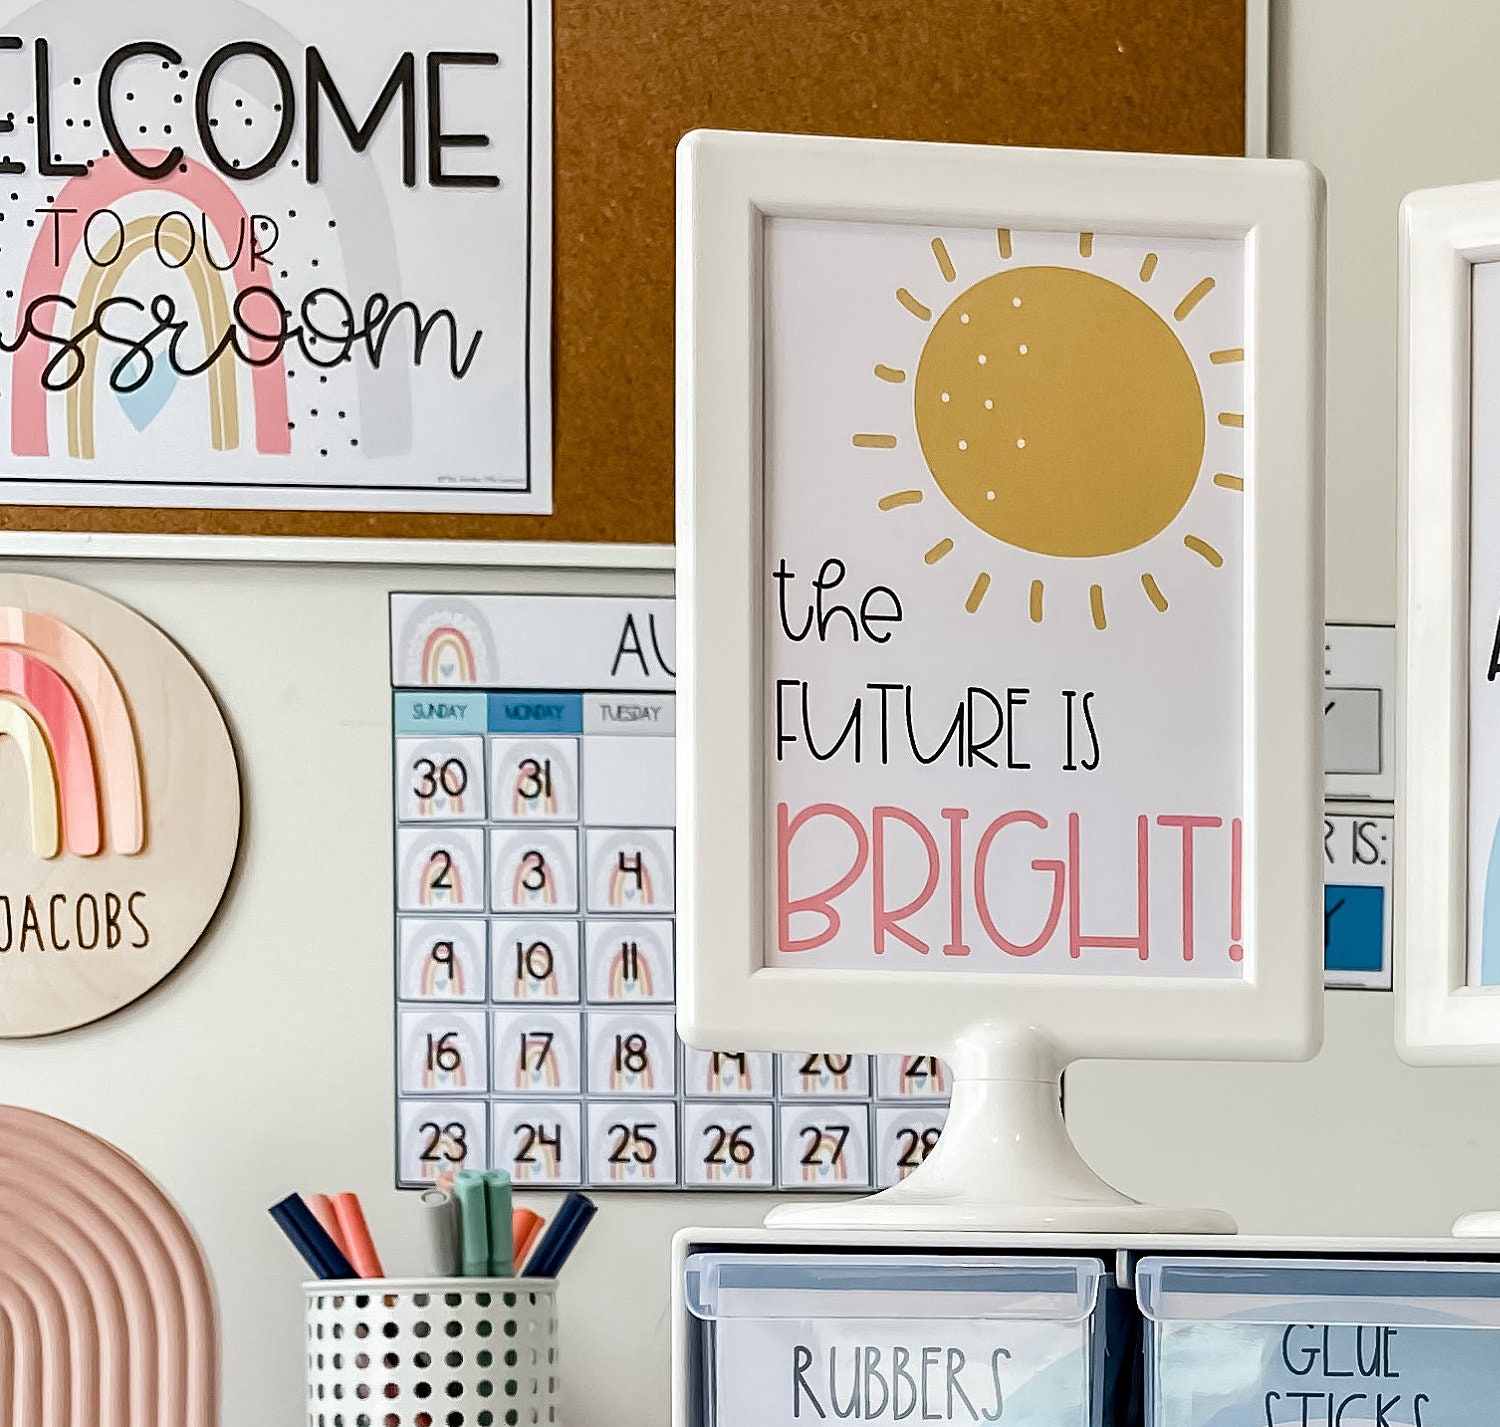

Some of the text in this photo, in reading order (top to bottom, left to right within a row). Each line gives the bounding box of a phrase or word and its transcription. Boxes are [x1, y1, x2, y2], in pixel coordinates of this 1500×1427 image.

[35, 209, 279, 272] TO OUR
[0, 286, 482, 391] ssroom
[772, 558, 903, 643] the
[413, 703, 662, 722] SUNDAY MONDAY TUESDAY
[776, 679, 1100, 772] FUTURE IS
[413, 758, 552, 800] 30 31
[430, 850, 643, 891] 2 3 4
[777, 802, 1243, 962] BRIGHT!
[430, 941, 639, 981] 9 10 11
[426, 1033, 461, 1073] 16
[520, 1033, 554, 1073] 17
[615, 1034, 649, 1075] 18
[419, 1122, 468, 1163] 23
[513, 1124, 562, 1164] 24
[607, 1124, 658, 1165] 25
[703, 1125, 755, 1165] 26
[799, 1126, 850, 1166] 27
[1282, 1324, 1400, 1378] GLUE
[793, 1345, 1012, 1422] RUBBERS
